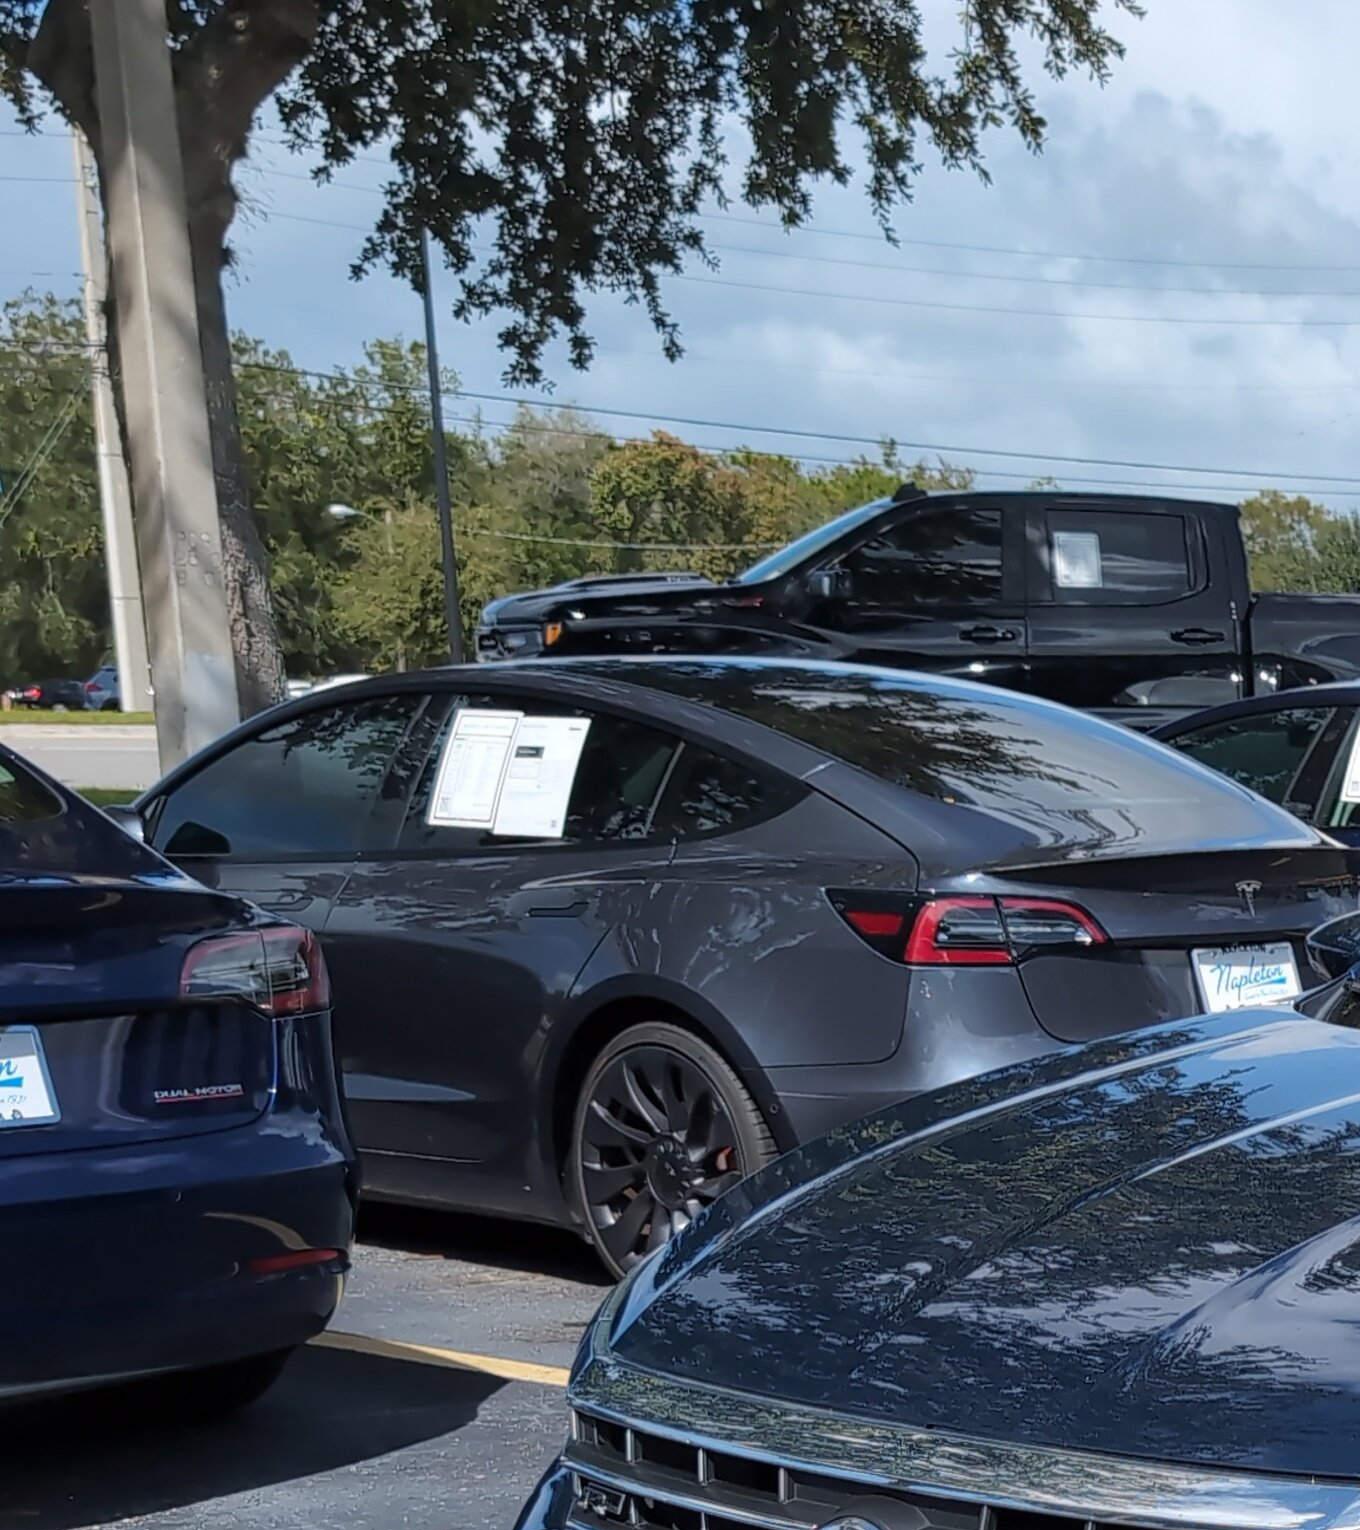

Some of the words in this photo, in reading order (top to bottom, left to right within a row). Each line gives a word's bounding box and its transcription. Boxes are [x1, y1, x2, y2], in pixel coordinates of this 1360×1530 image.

[1209, 955, 1284, 1001] Napleton
[154, 1090, 192, 1100] DUAL
[195, 1083, 242, 1096] MOTOR
